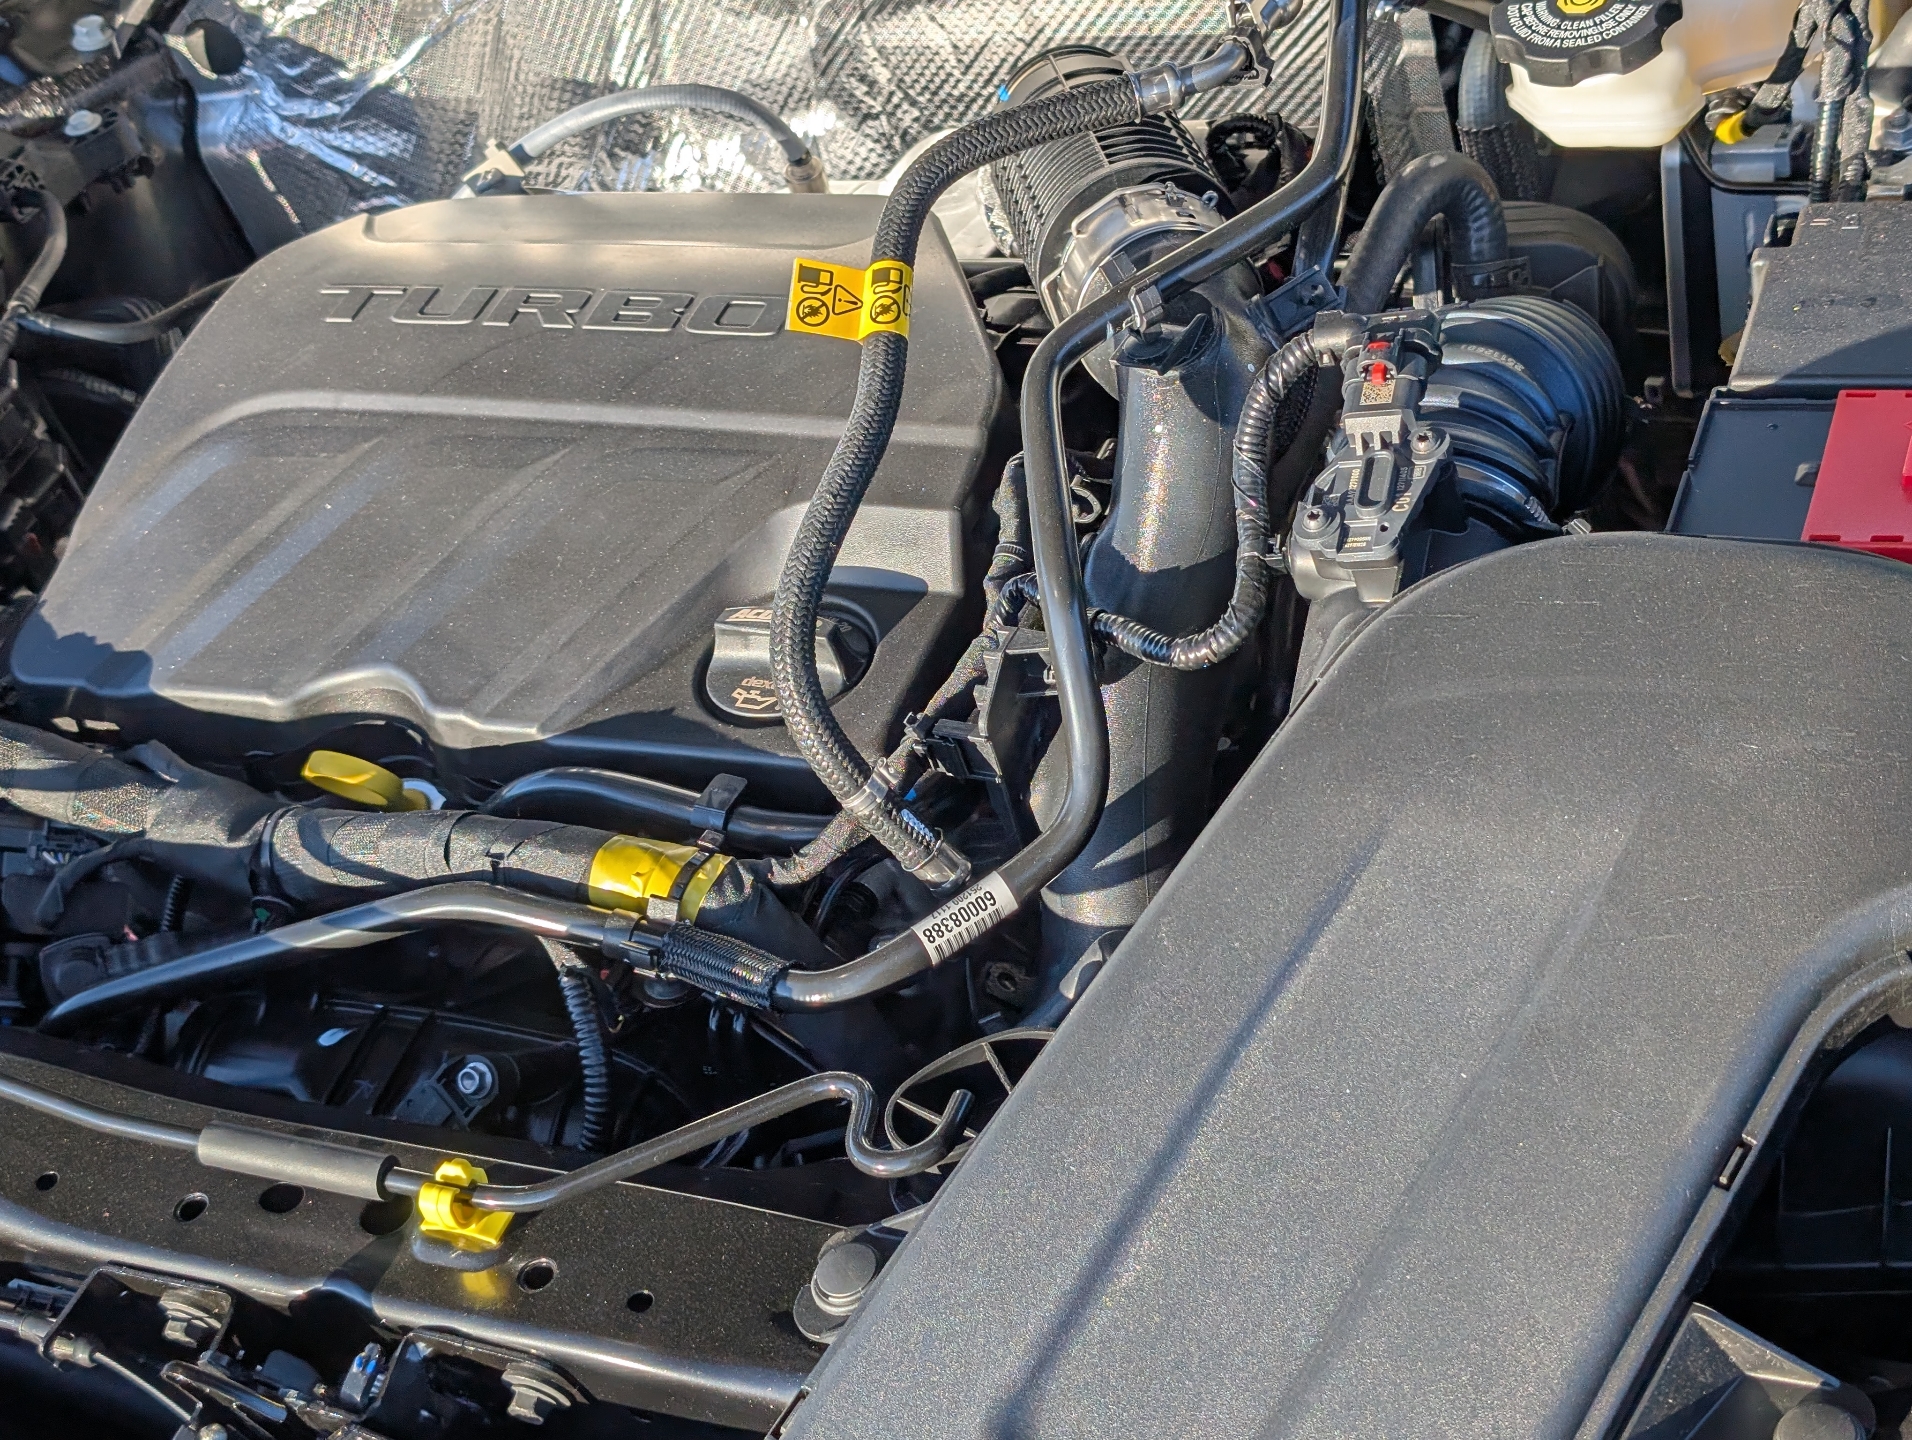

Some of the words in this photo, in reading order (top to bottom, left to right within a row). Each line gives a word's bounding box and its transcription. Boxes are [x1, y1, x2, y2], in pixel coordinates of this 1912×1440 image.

[1507, 4, 1520, 18] DOT
[1521, 3, 1533, 15] CAP
[1561, 20, 1593, 29] CLEAN
[1594, 3, 1625, 24] FILLER
[1615, 4, 1637, 22] ONLY
[1510, 20, 1531, 38] FLUID
[1523, 15, 1551, 35] BEFORE
[1598, 18, 1618, 31] USE
[1526, 33, 1555, 47] FROM
[1552, 38, 1562, 48] A
[1561, 34, 1602, 48] SEALED
[320, 284, 789, 336] TURBO
[922, 890, 996, 944] 60008388
